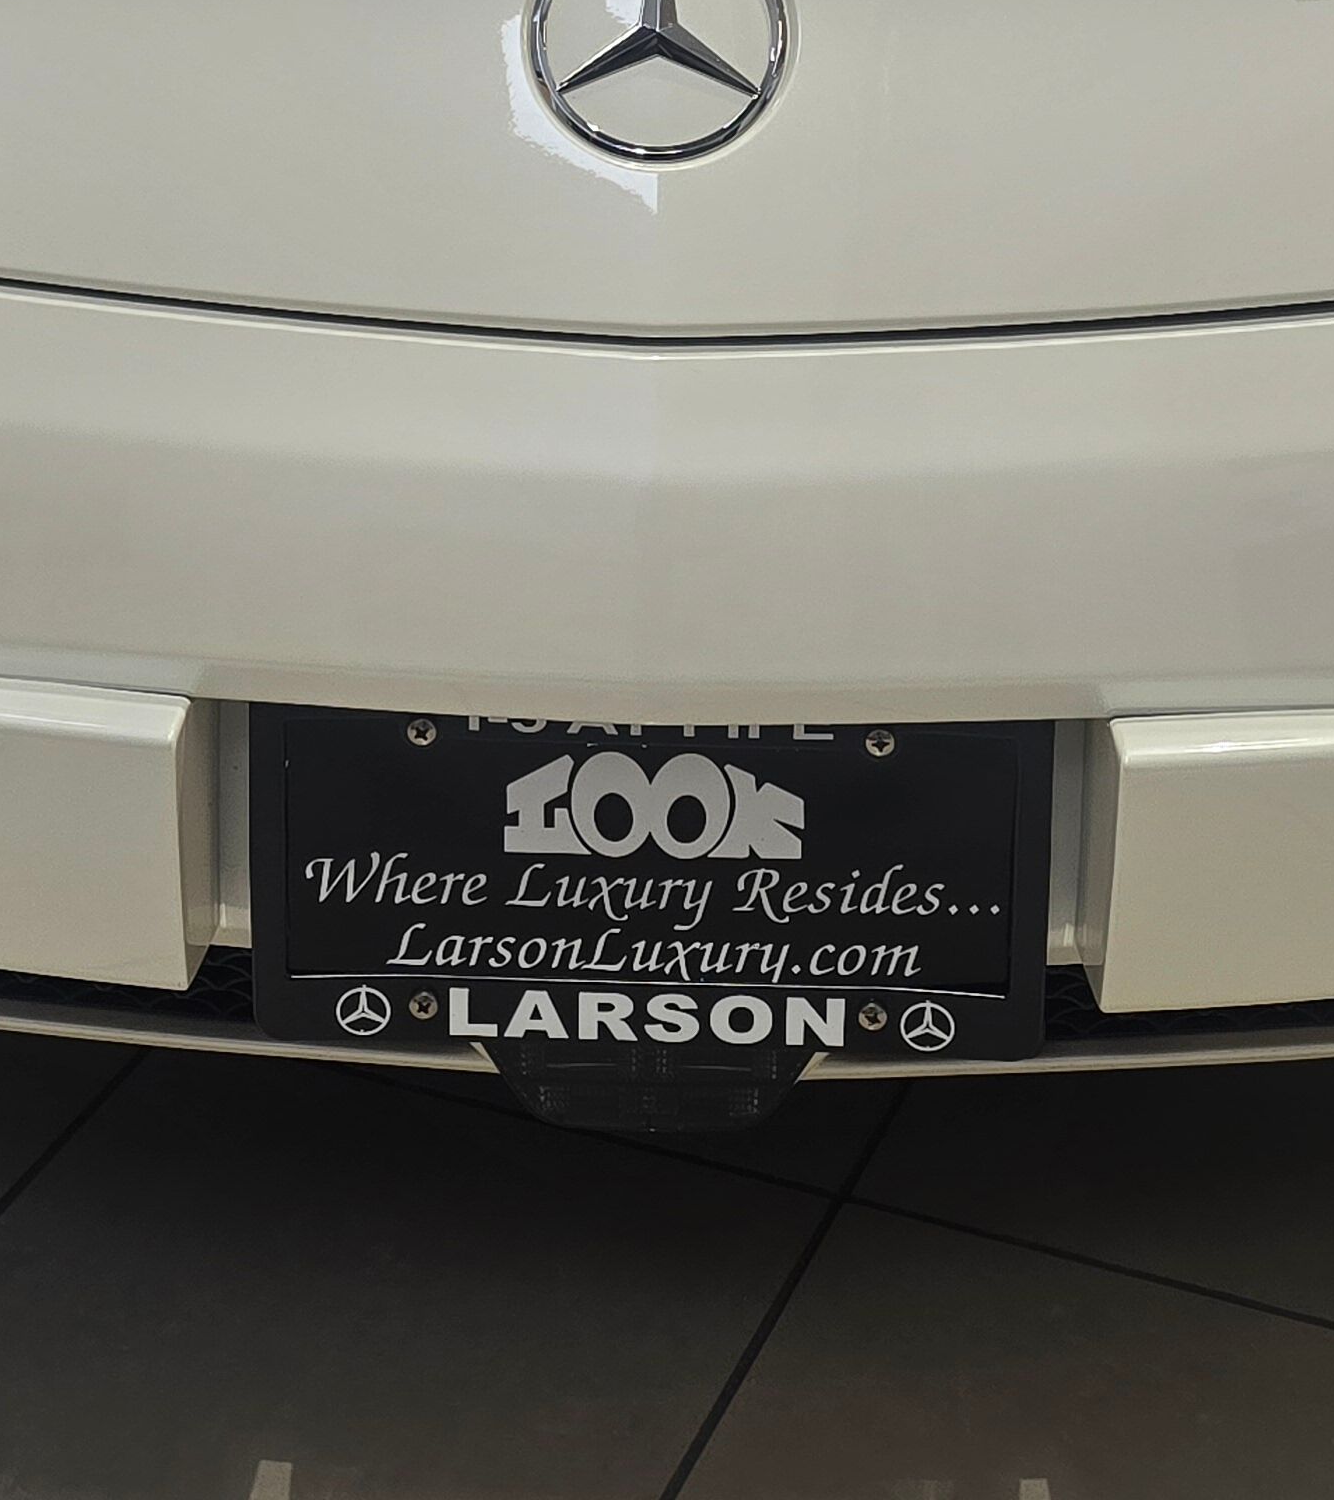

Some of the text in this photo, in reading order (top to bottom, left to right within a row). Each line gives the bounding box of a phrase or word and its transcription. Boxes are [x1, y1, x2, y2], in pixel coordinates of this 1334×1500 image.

[305, 852, 1001, 931] Where Luxury Resides...
[385, 922, 921, 984] LarsonLuxury.com
[449, 987, 846, 1047] LARSON
